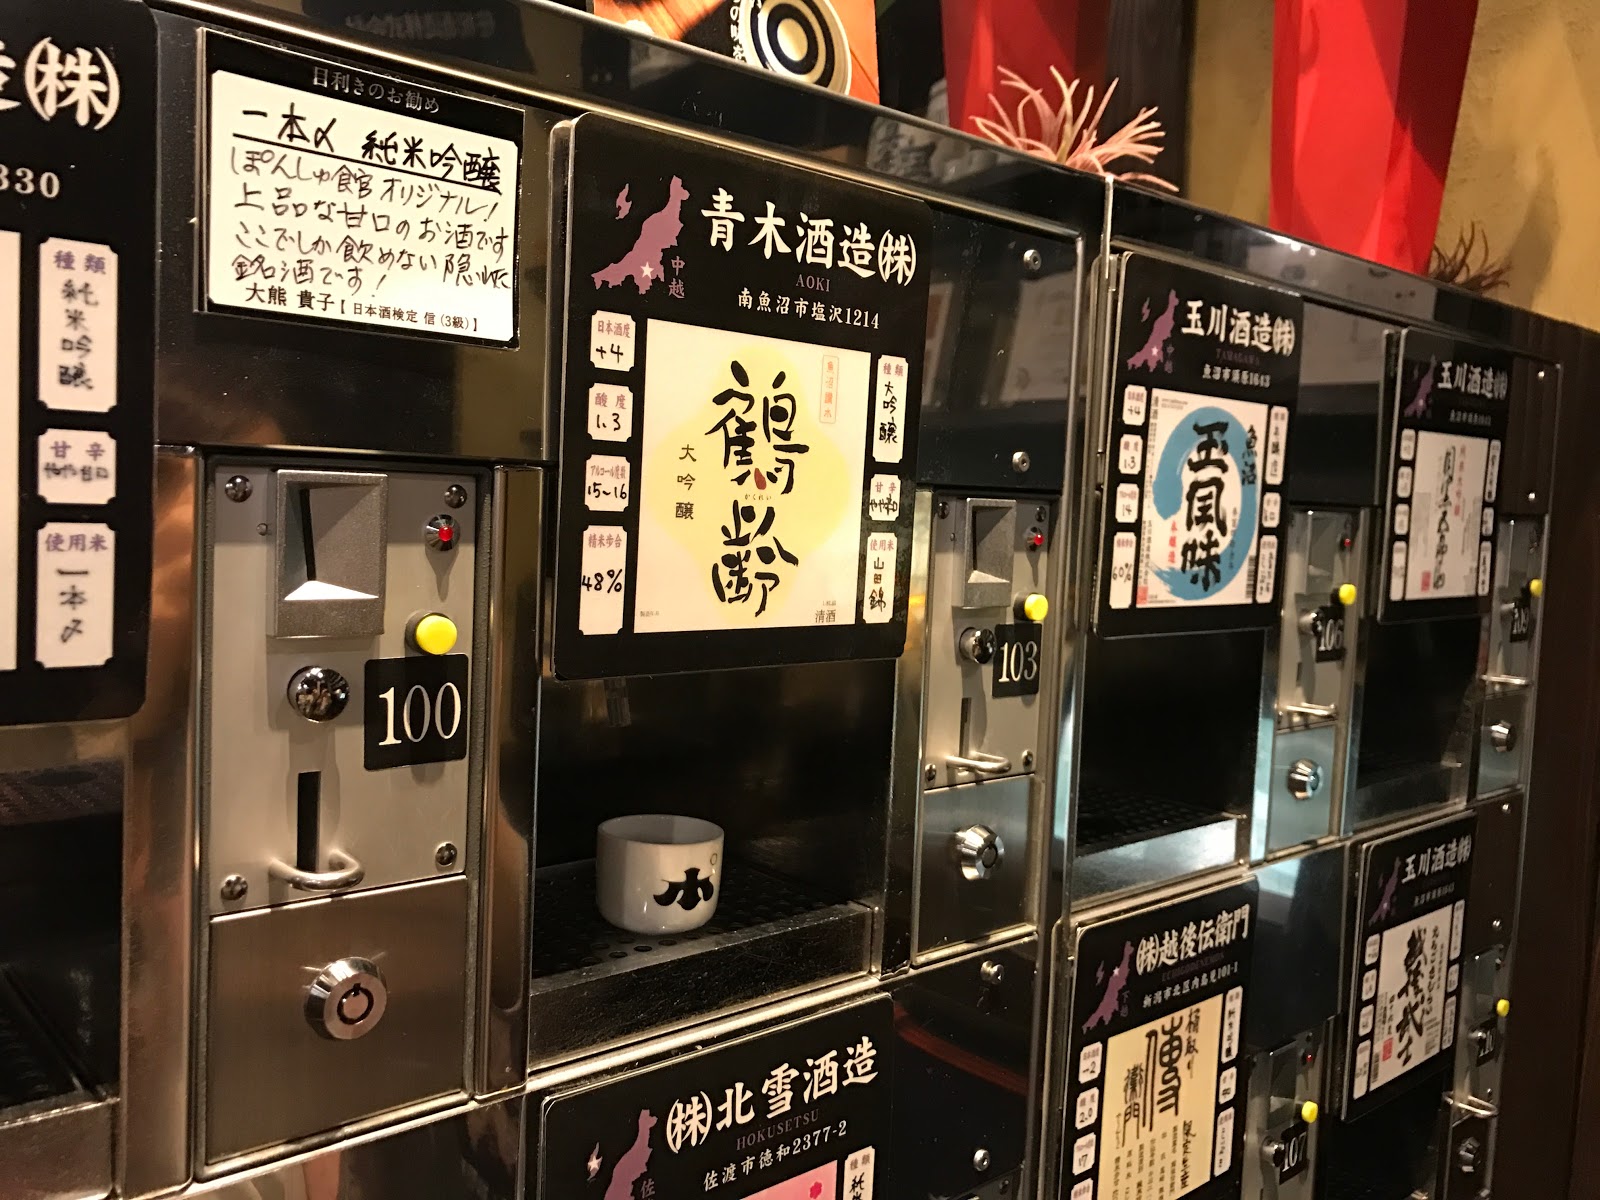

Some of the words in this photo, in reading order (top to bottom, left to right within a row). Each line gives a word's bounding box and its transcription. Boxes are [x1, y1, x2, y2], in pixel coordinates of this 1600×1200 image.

[53, 250, 107, 275] 種類
[668, 256, 686, 299] 中越
[795, 273, 831, 293] AOKI
[737, 287, 880, 331] 南魚沼市塩沢1214
[597, 319, 631, 339] 日本酒度
[595, 343, 624, 363] +4
[594, 392, 627, 410] 酸度
[879, 381, 898, 444] 大吟醸
[675, 443, 697, 520] 大吟醸
[44, 533, 108, 552] 使用米
[588, 533, 623, 549] 精米歩合
[869, 539, 895, 552] 使用米
[581, 568, 623, 593] 48%
[868, 556, 887, 612] 山田錦
[814, 609, 836, 624] 清酒
[998, 641, 1038, 683] 103
[378, 682, 462, 746] 100
[1079, 1107, 1093, 1123] 2.0
[736, 1108, 820, 1150] HOKUSETSU
